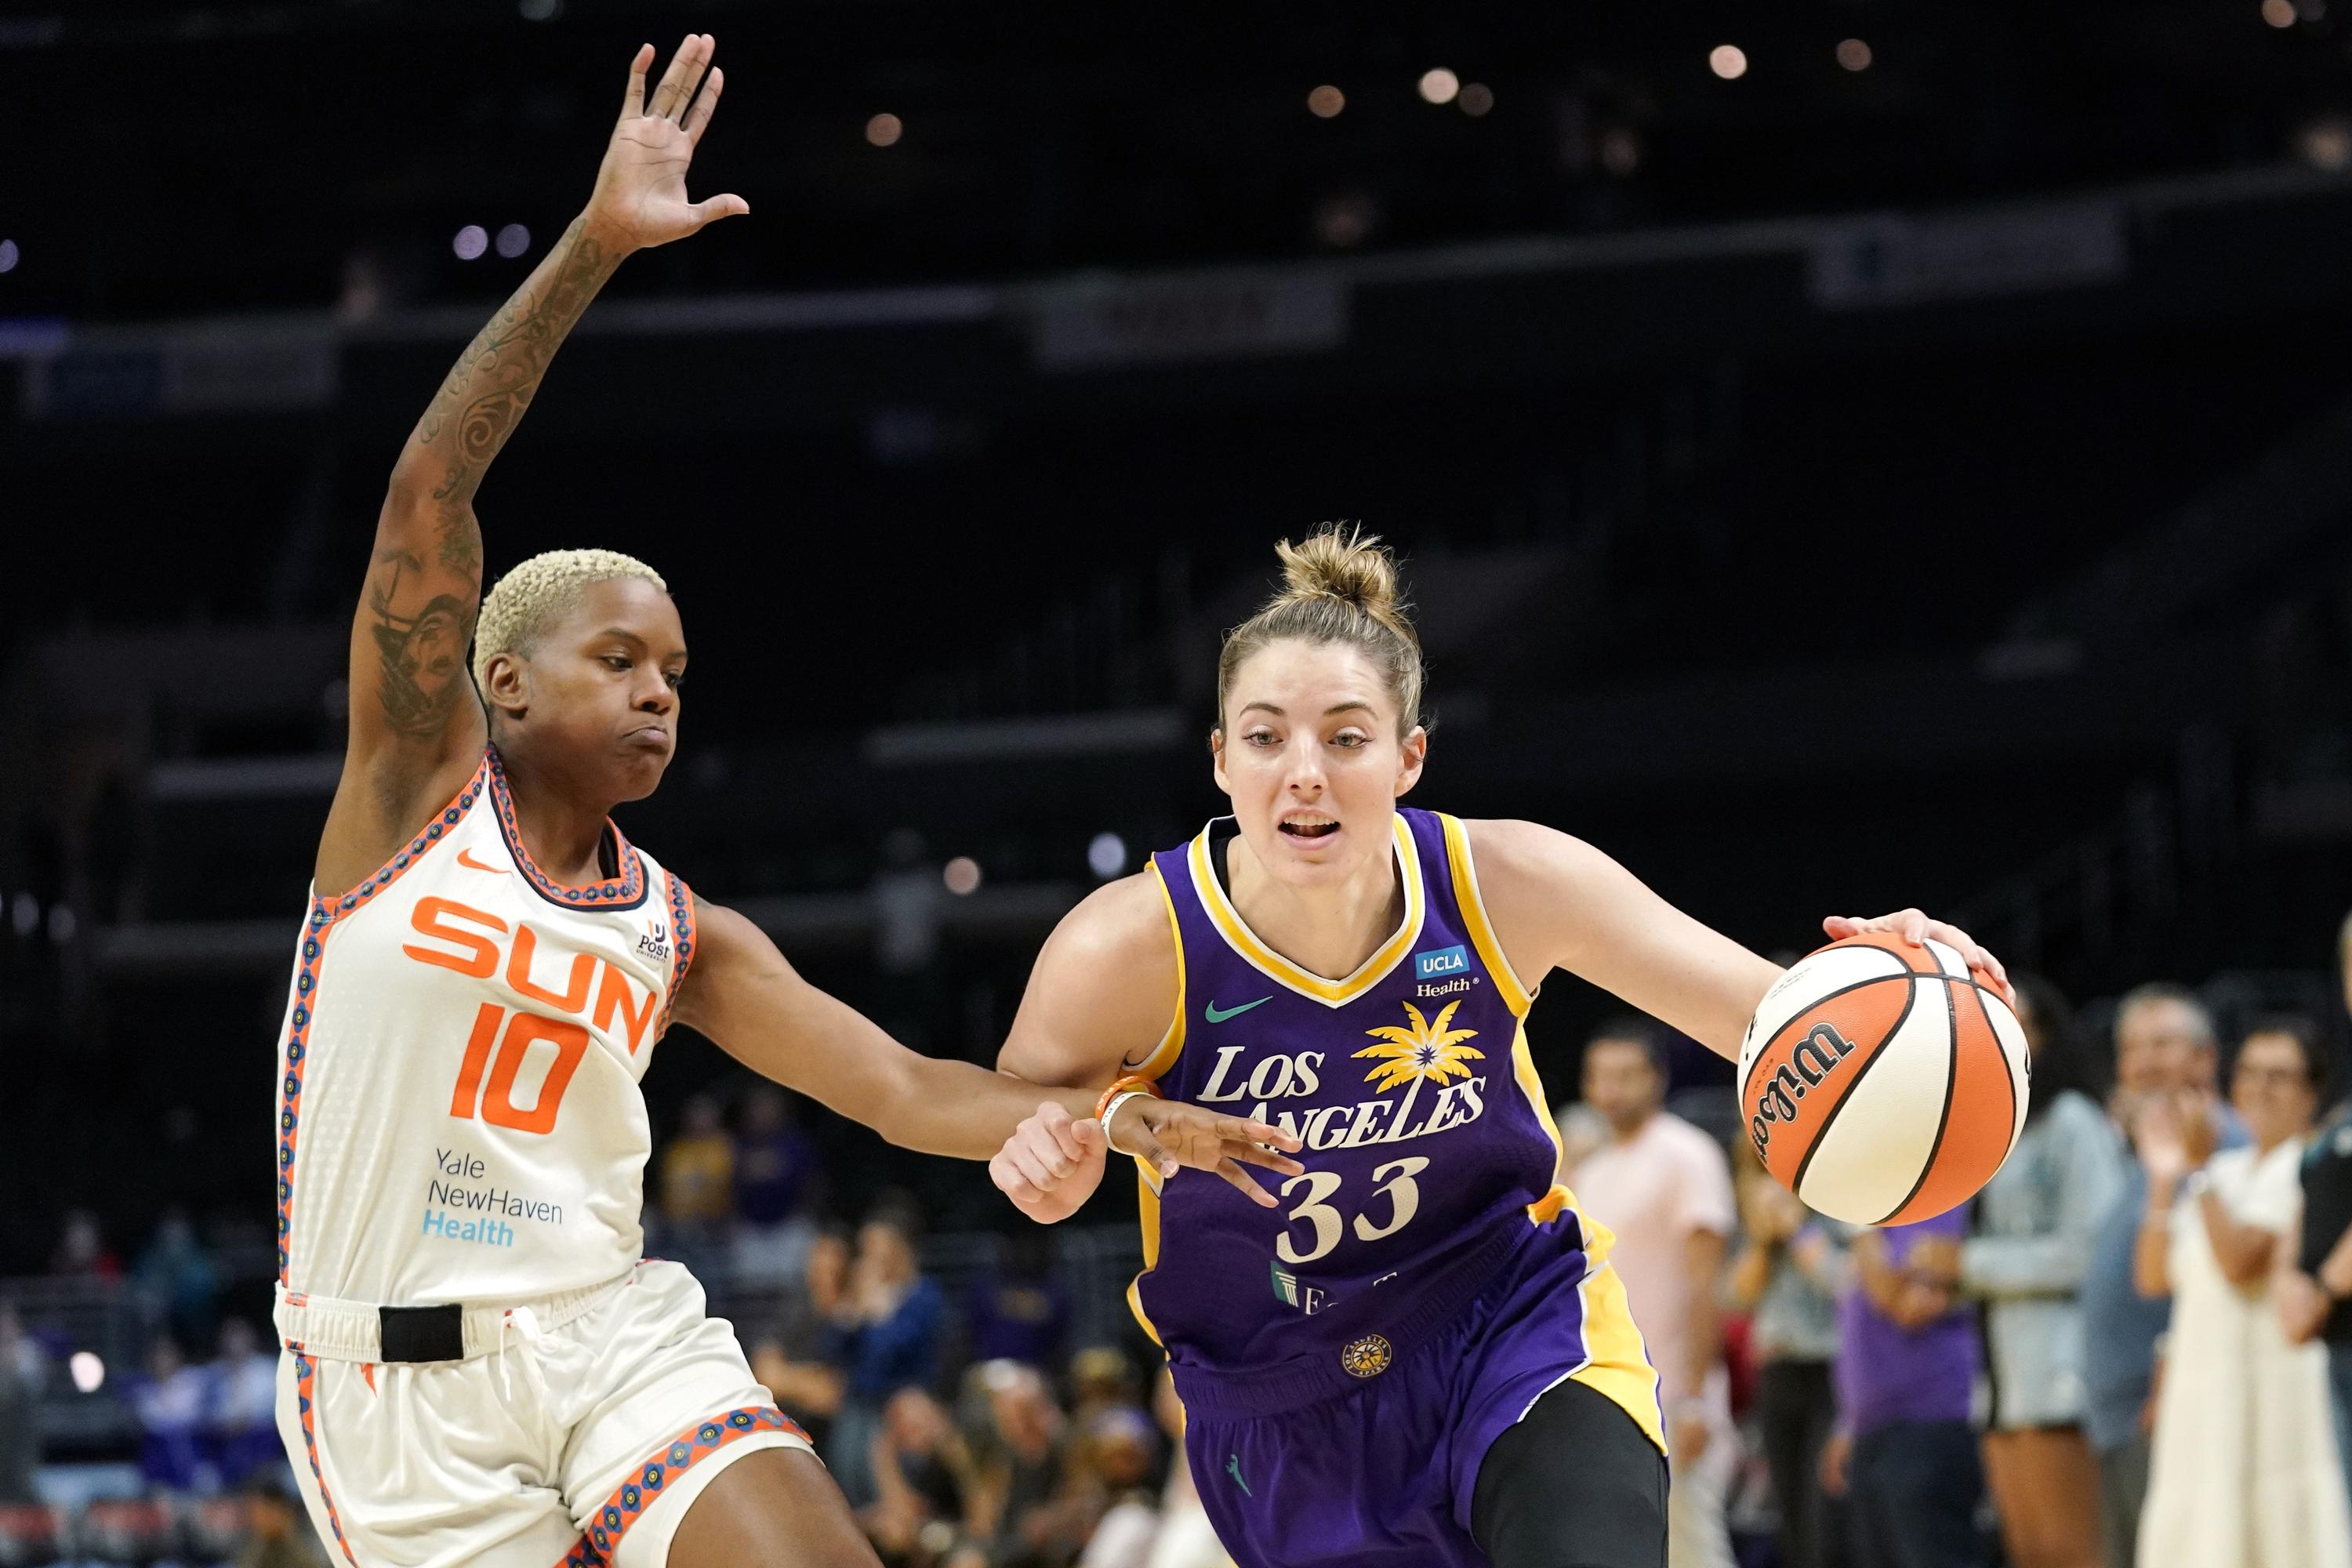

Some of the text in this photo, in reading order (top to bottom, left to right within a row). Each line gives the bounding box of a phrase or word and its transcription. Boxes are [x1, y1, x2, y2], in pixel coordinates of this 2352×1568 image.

[638, 934, 670, 959] Post
[1423, 953, 1464, 973] UCLA
[403, 896, 658, 1056] SUN
[450, 1002, 590, 1134] 10
[1196, 1046, 1326, 1102] LOS
[1752, 1022, 1857, 1166] Wilson
[437, 1148, 485, 1178] Yale
[428, 1180, 563, 1225] NewHaven
[1276, 1156, 1430, 1264] 33
[423, 1209, 514, 1247] Health
